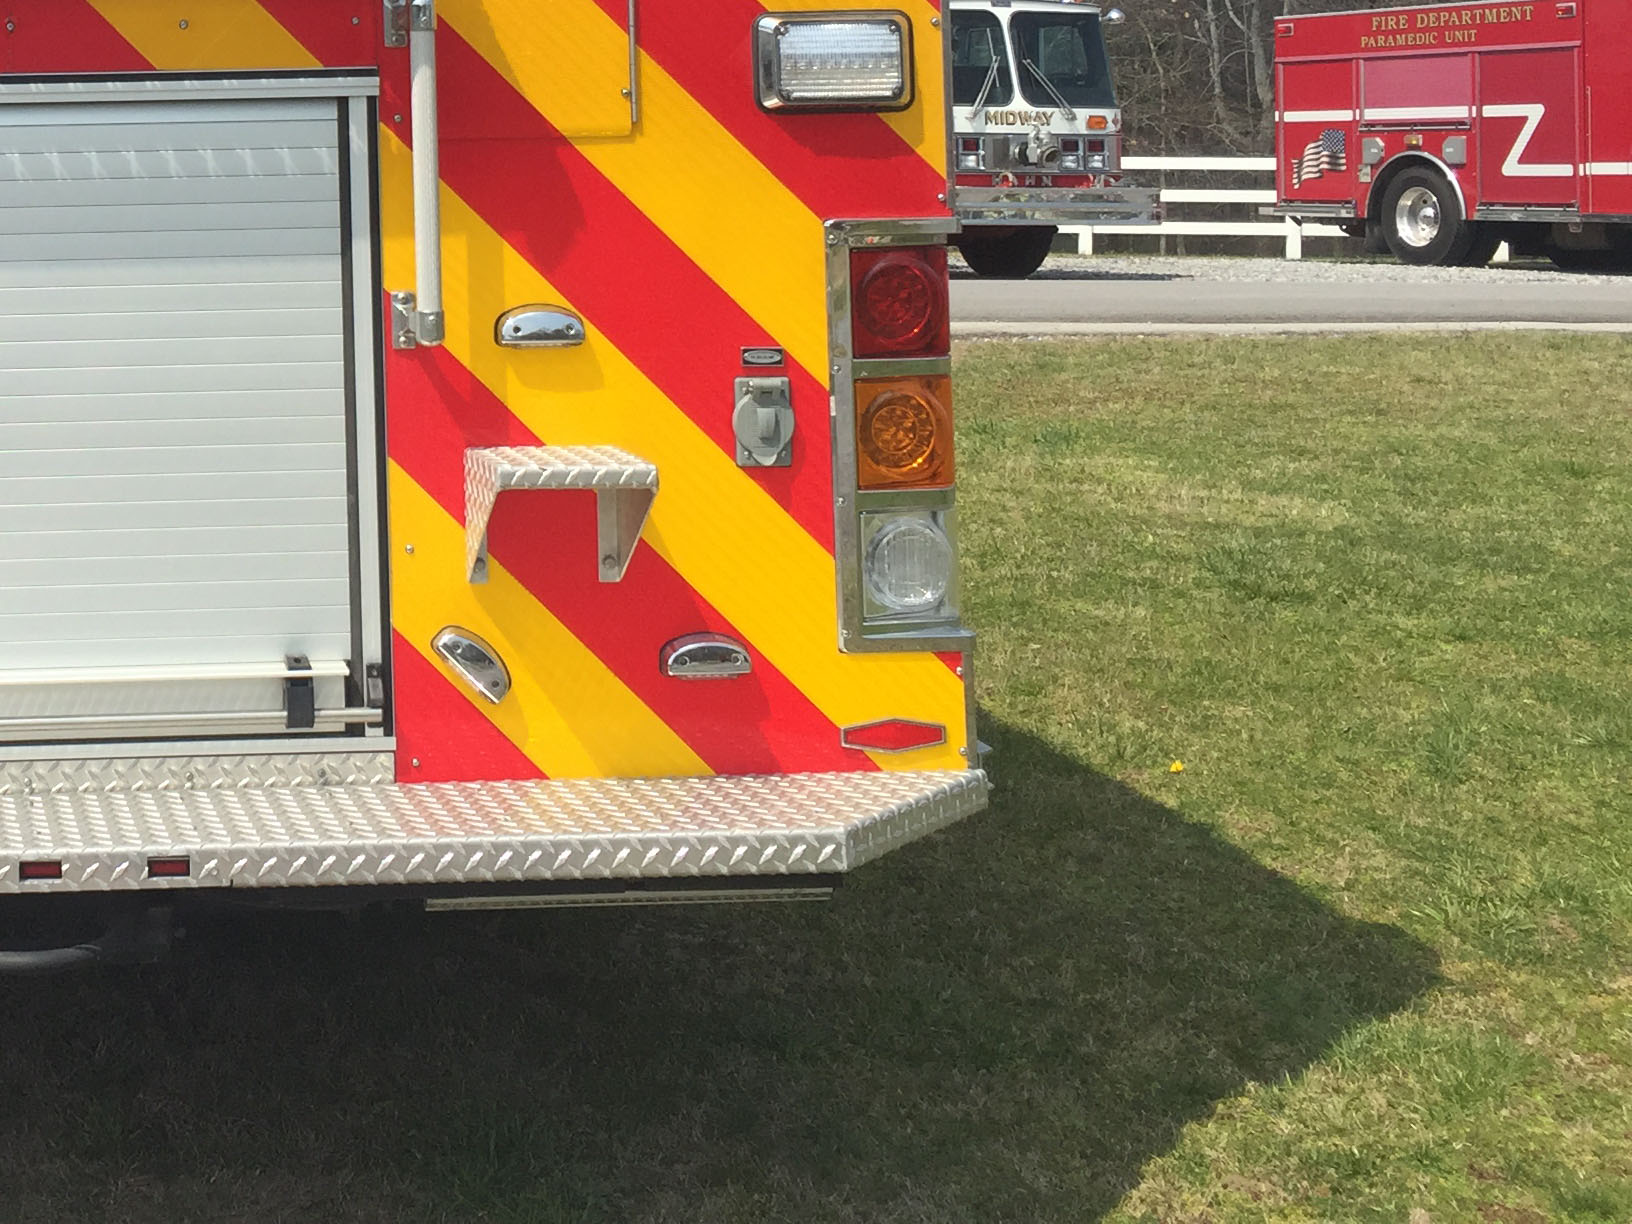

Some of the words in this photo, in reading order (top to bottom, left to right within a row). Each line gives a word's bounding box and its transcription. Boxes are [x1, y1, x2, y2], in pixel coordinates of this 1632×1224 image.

[1371, 14, 1409, 31] FIRE
[1416, 5, 1535, 28] DEPARTMENT
[1360, 32, 1438, 48] PARAMEDIC
[1444, 29, 1478, 43] UNIT
[984, 110, 1056, 126] MIDWAY
